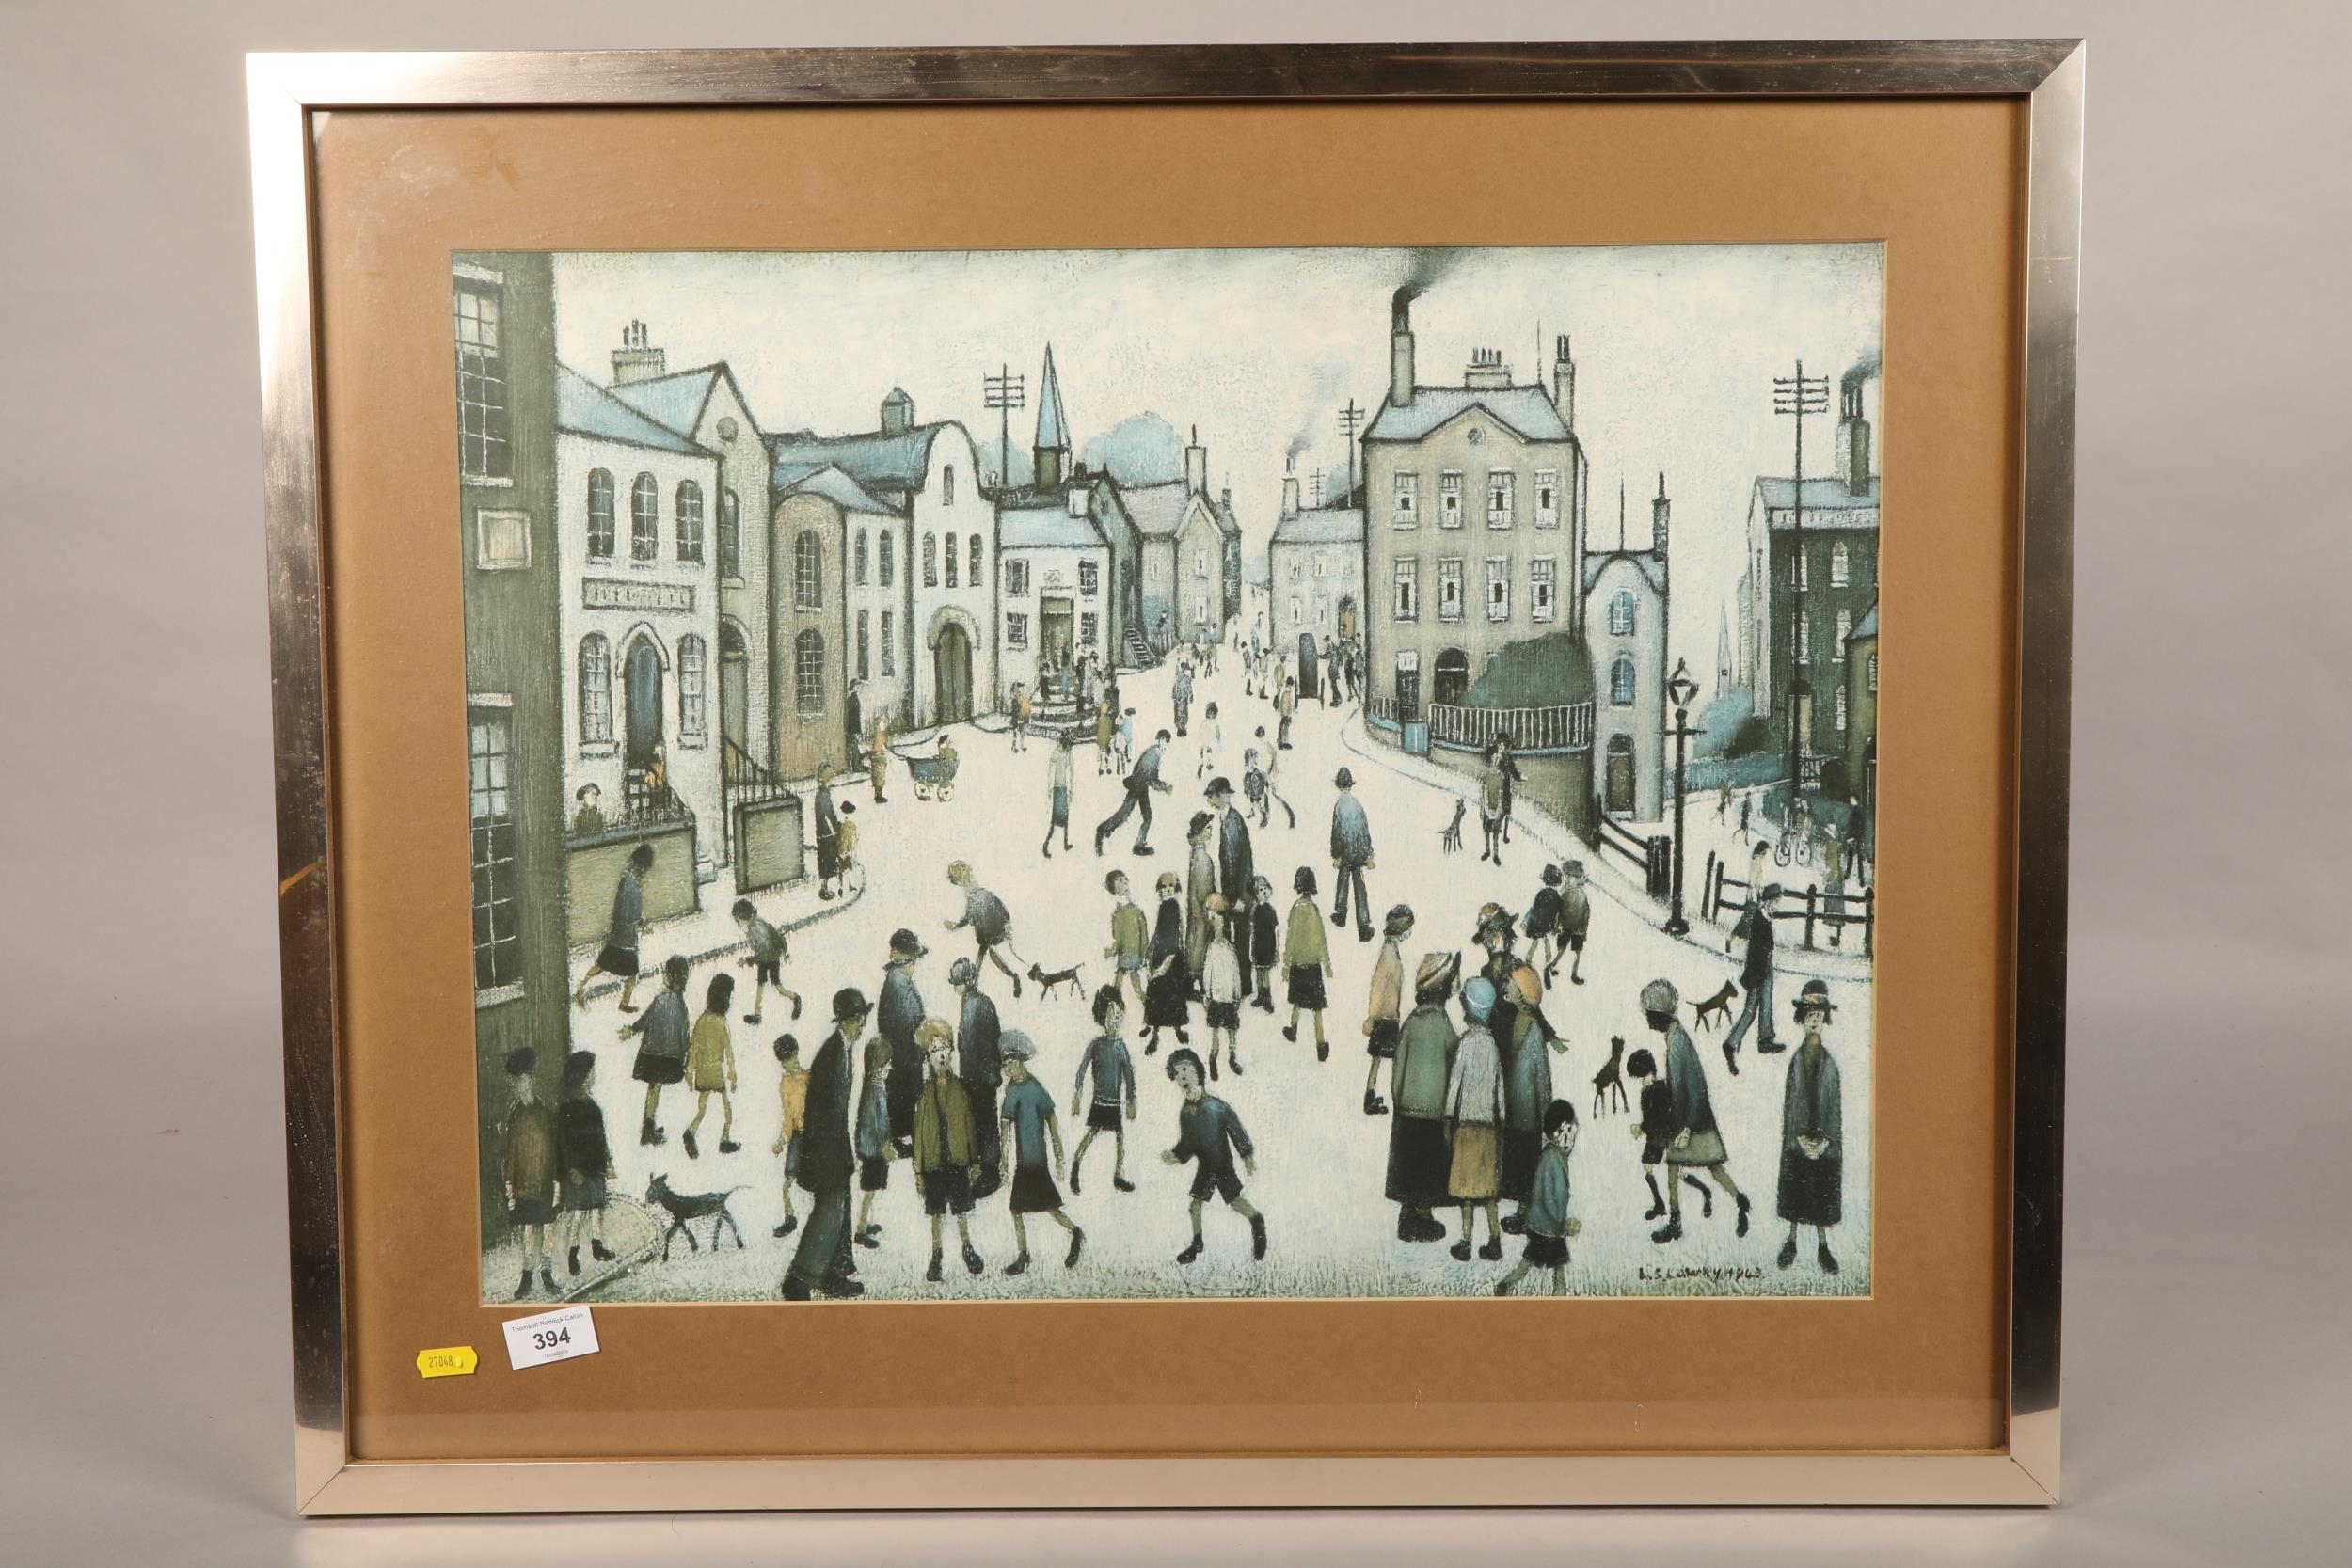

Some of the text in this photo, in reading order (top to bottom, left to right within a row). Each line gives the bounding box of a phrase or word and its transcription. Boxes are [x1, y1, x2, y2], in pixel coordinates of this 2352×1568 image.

[512, 1323, 539, 1332] Thomson
[532, 1326, 571, 1351] 394
[428, 1355, 453, 1368] 27048
